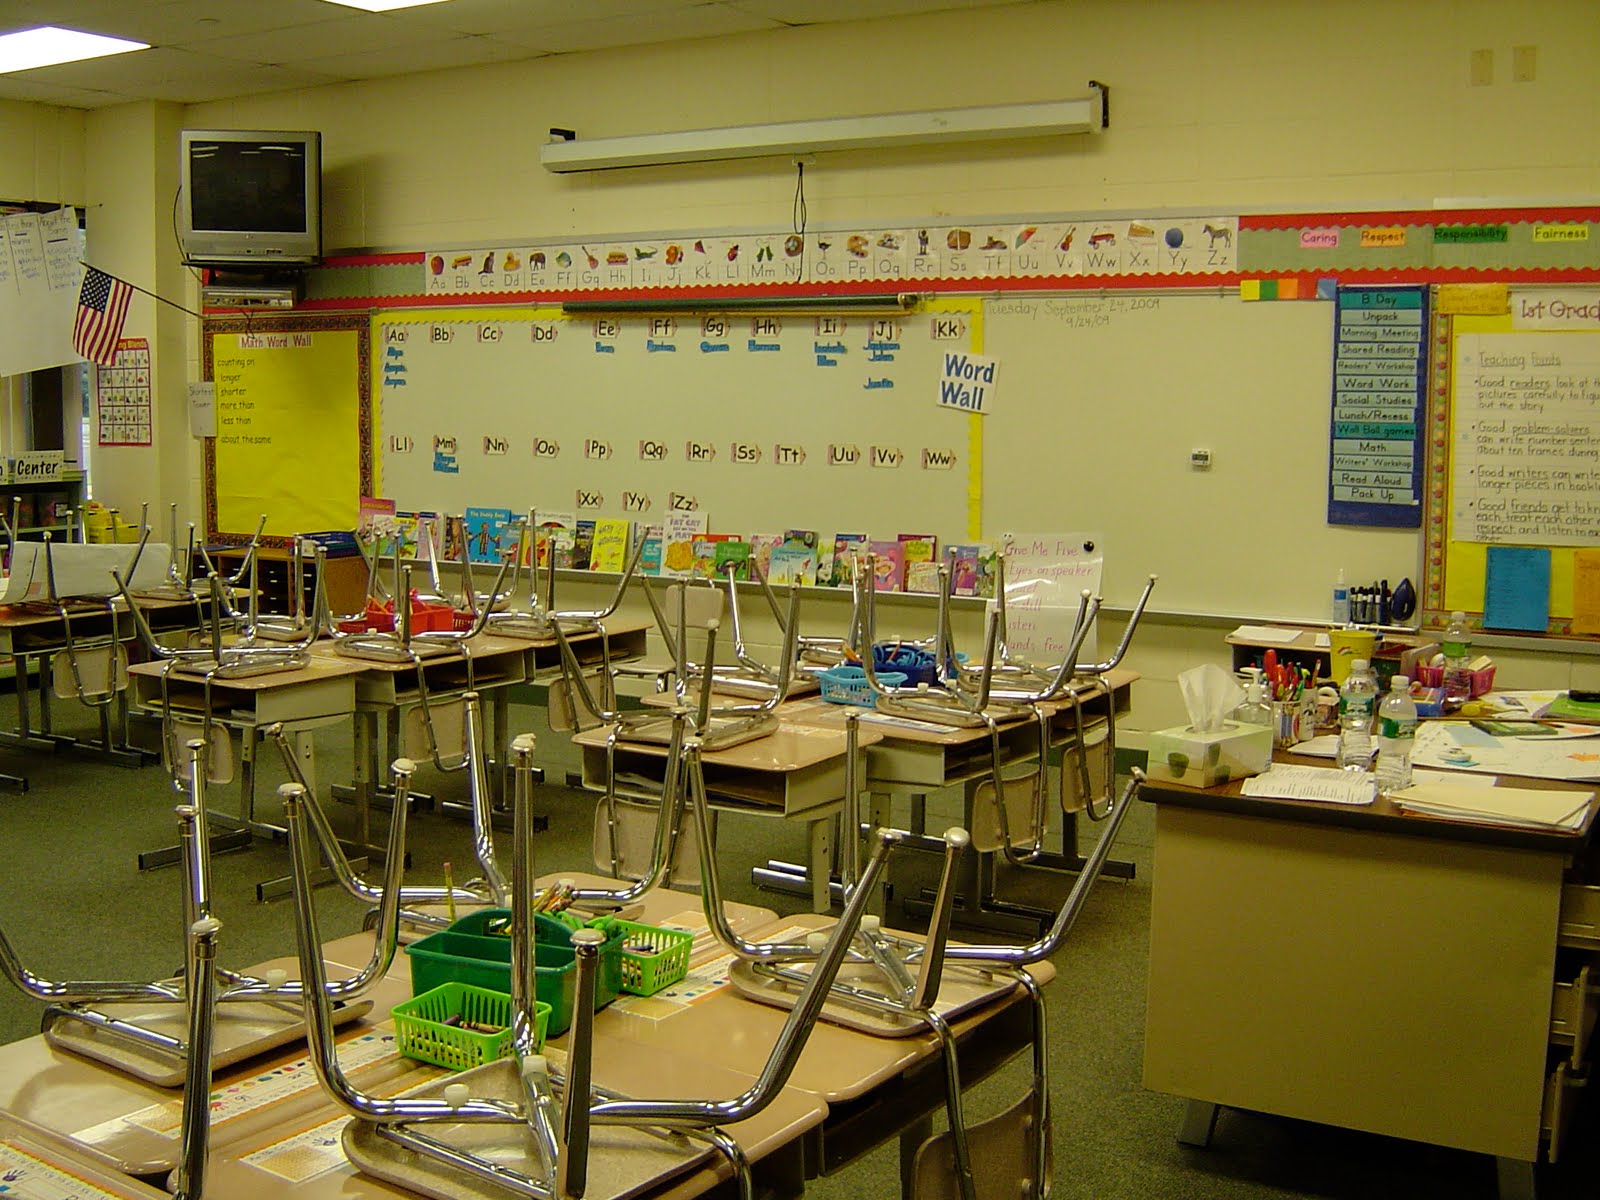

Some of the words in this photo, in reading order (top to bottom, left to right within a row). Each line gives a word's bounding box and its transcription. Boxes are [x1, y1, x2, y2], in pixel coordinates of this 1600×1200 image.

[1301, 231, 1338, 245] Caring
[1361, 231, 1405, 244] Respect
[1534, 226, 1587, 240] Fairness
[430, 277, 446, 289] Aa
[455, 276, 470, 288] Bb
[480, 275, 495, 288] Cc
[504, 274, 519, 287] Dd
[530, 273, 545, 286] Ee
[557, 272, 571, 285] Ff
[610, 270, 625, 283] Hh
[726, 264, 739, 279] Ll
[751, 264, 776, 278] Mm
[816, 261, 836, 276] Oo
[848, 260, 866, 279] Pp
[879, 259, 900, 278] Qq
[914, 258, 933, 272] Rr
[950, 257, 966, 271] Ss
[985, 256, 1002, 270] Tt
[1019, 255, 1038, 270] Uu
[1056, 254, 1073, 268] Vv
[1087, 253, 1116, 267] Ww
[1130, 252, 1150, 266] Xx
[1169, 250, 1188, 273] Yy
[1207, 250, 1227, 266] Zz
[1362, 294, 1371, 304] B
[1376, 294, 1397, 306] Day
[986, 300, 1038, 320] Tuesday
[1044, 300, 1104, 321] September
[1362, 312, 1398, 324] Unpack
[389, 329, 404, 341] Aa
[434, 327, 449, 341] Bb
[482, 327, 497, 340] Cc
[536, 327, 553, 340] Dd
[598, 321, 614, 335] Ee
[654, 320, 670, 335] Ff
[706, 318, 724, 336] Gg
[756, 320, 776, 334] Hh
[822, 319, 837, 334] Ii
[875, 321, 892, 340] Jj
[938, 321, 958, 337] Kk
[1341, 328, 1378, 340] Morning
[1382, 328, 1419, 340] Meeting
[241, 337, 263, 349] Math
[267, 336, 288, 348] Word
[293, 335, 312, 346] Wall
[1341, 344, 1374, 354] Shared
[1377, 344, 1415, 357] Reading
[217, 358, 245, 369] counting
[247, 358, 255, 366] on
[945, 353, 995, 384] Word
[1375, 361, 1414, 372] Workshop
[220, 374, 241, 385] longer
[1343, 378, 1373, 389] Word
[1379, 378, 1409, 389] Work
[1479, 375, 1505, 388] Good
[220, 387, 247, 398] shorter
[941, 380, 984, 411] Wall
[220, 402, 238, 410] more
[239, 401, 255, 410] than
[1341, 394, 1369, 405] Social
[1375, 395, 1412, 405] Studies
[221, 417, 234, 425] less
[236, 416, 252, 425] than
[1339, 409, 1408, 422] Lunch/Recess
[1338, 424, 1359, 434] Wall
[1363, 425, 1381, 435] Ball
[1383, 428, 1414, 438] games
[1478, 420, 1505, 433] Good
[220, 436, 240, 444] about
[1477, 436, 1494, 444] can
[1528, 435, 1566, 445] number
[487, 439, 504, 452] Nn
[537, 441, 555, 454] Oo
[591, 440, 606, 458] Pp
[644, 442, 662, 459] Qq
[692, 444, 709, 459] Rr
[737, 445, 755, 460] Ss
[781, 448, 799, 463] Tt
[833, 447, 854, 462] Uu
[878, 449, 896, 463] Vv
[927, 452, 950, 465] Ww
[1359, 442, 1386, 453] Math
[1527, 446, 1564, 457] frames
[17, 459, 59, 475] Center
[1373, 458, 1412, 469] Workshop
[1478, 464, 1504, 478] Good
[1552, 470, 1571, 479] can
[1342, 474, 1367, 484] Read
[1373, 475, 1402, 485] Aloud
[1478, 479, 1510, 495] longer
[1515, 480, 1549, 493] pieces
[1554, 481, 1565, 490] in
[1351, 488, 1374, 498] Pack
[1380, 489, 1394, 501] Up
[581, 492, 599, 505] Xx
[628, 492, 645, 511] Yy
[675, 495, 693, 511] Zz
[1478, 497, 1507, 511] Good
[1511, 498, 1548, 513] friends
[1535, 513, 1562, 524] each
[1518, 525, 1539, 535] and
[1032, 541, 1048, 556] Me
[1056, 541, 1079, 556] Five
[1044, 637, 1064, 652] free
